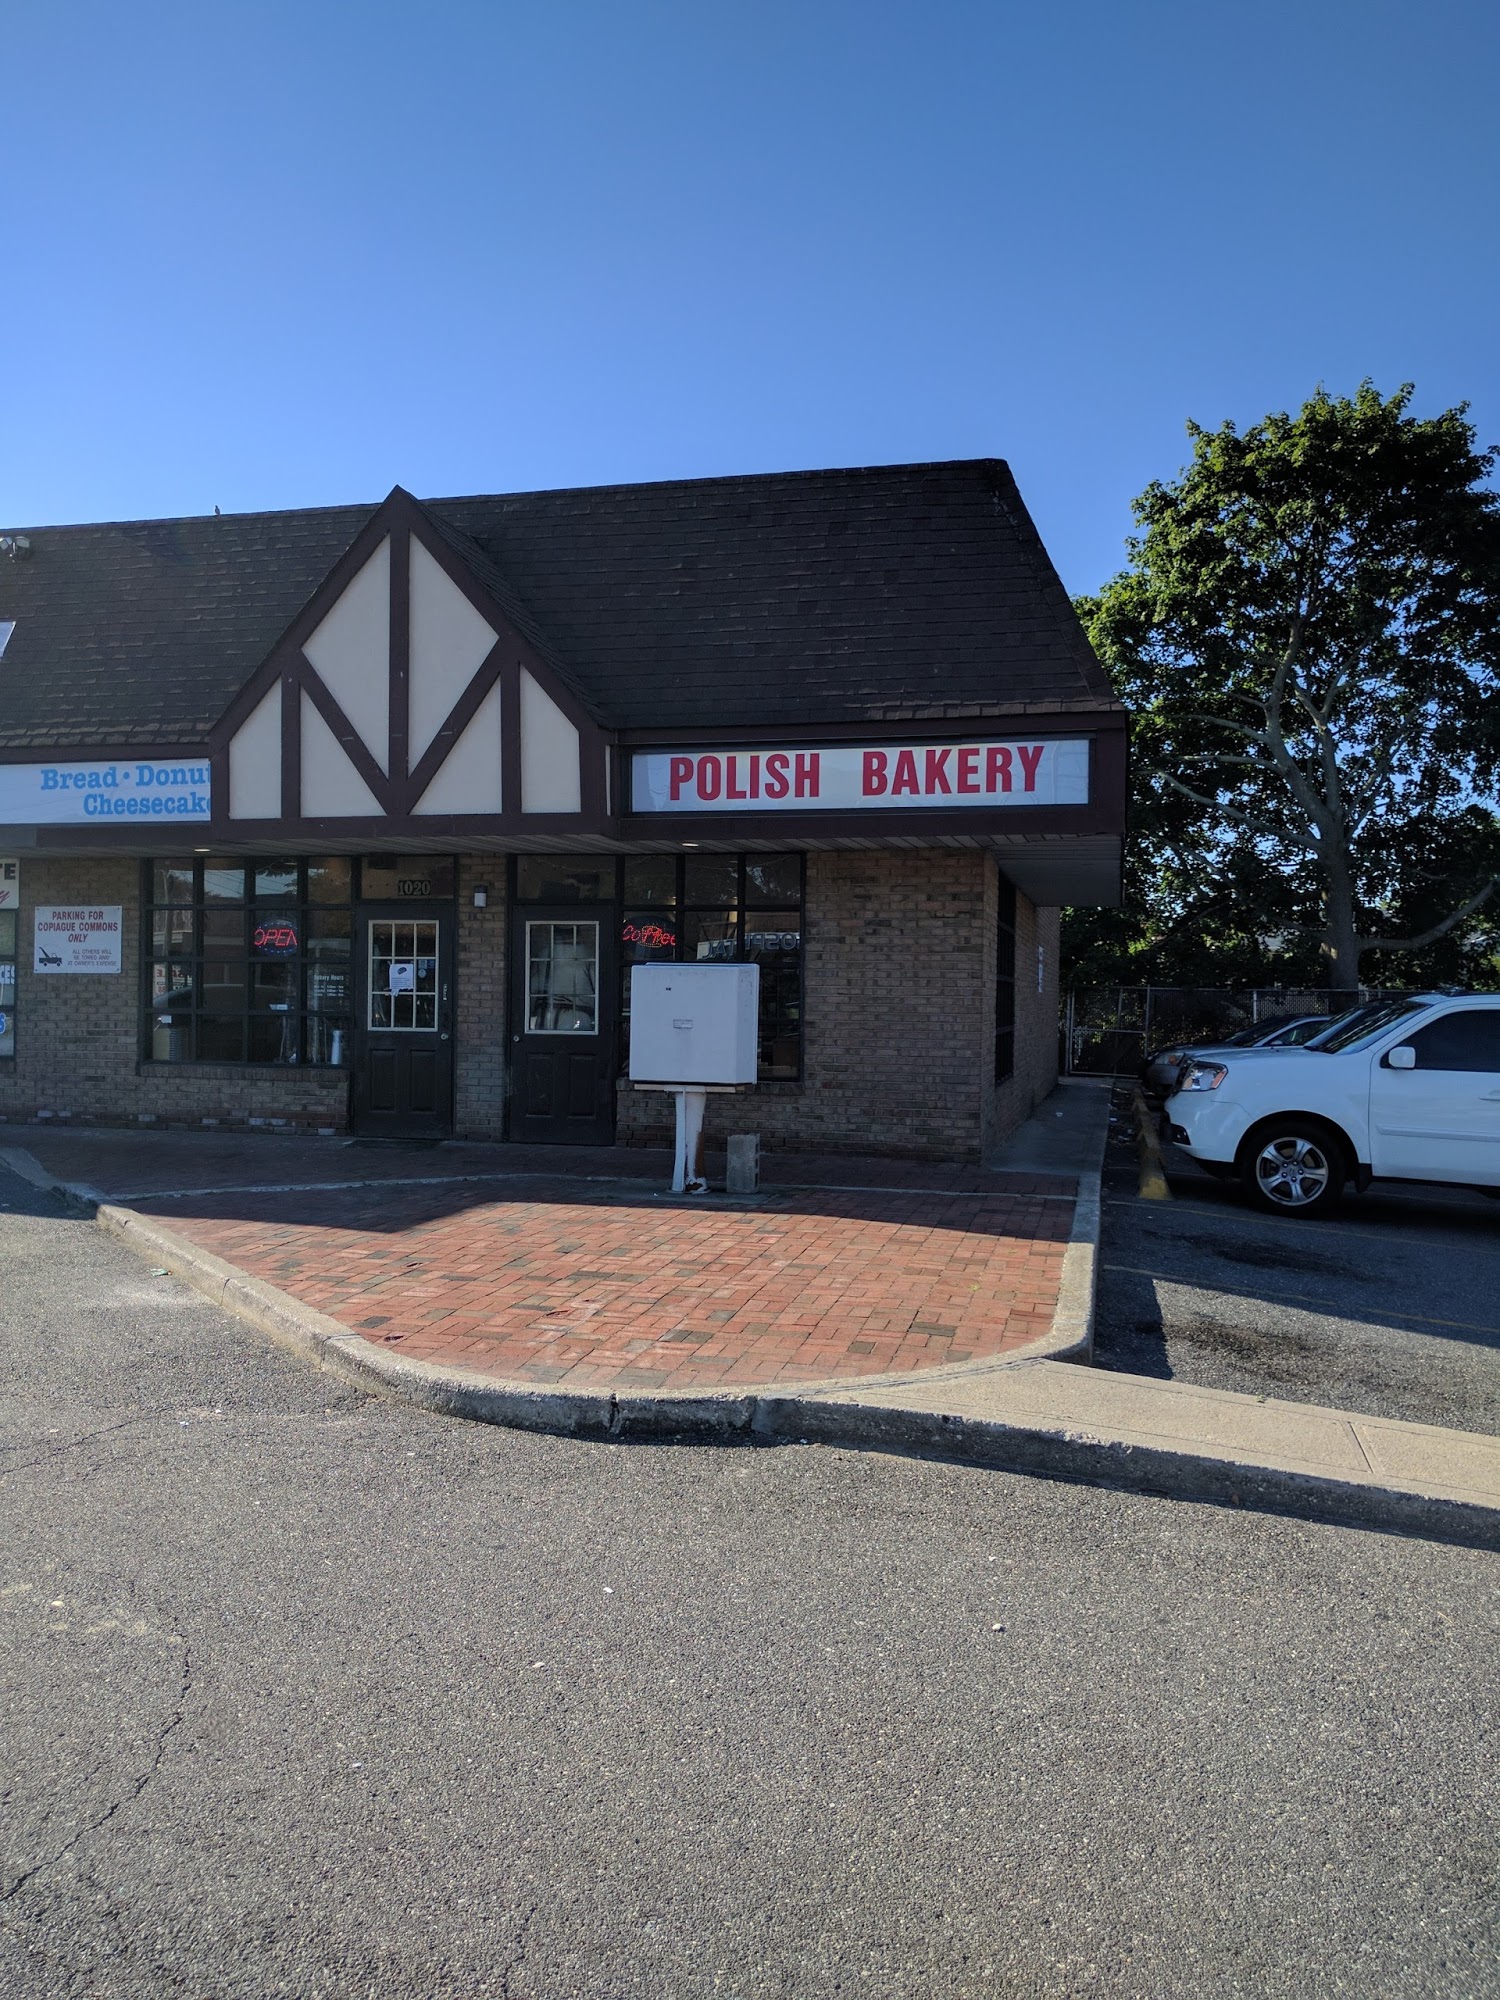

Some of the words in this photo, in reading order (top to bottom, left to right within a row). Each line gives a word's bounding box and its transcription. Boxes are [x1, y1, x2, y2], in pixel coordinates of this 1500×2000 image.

[40, 766, 119, 791] Bread
[670, 753, 820, 801] POLISH
[862, 746, 1044, 796] BAKERY
[398, 880, 431, 896] 1020
[52, 911, 86, 920] PARKING
[88, 911, 104, 920] FOR
[37, 922, 76, 932] COPIAGUE
[78, 922, 119, 932] COMMONS
[622, 924, 676, 946] Coffee
[67, 933, 88, 943] ONLY
[254, 928, 298, 946] OPEN
